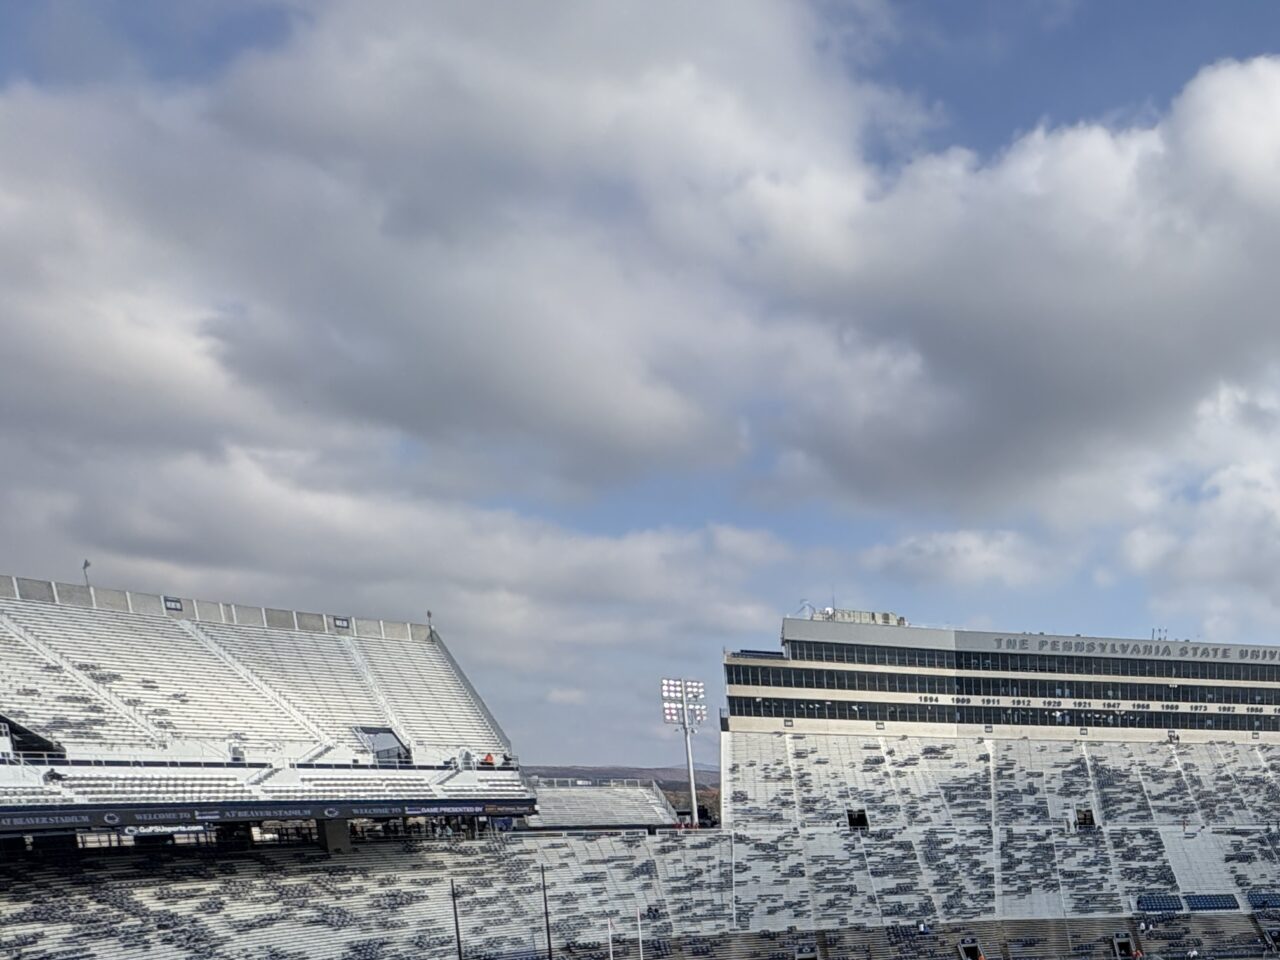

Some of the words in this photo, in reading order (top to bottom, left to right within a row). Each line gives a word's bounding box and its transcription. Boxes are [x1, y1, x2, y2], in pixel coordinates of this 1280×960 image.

[994, 638, 1029, 650] THE
[1038, 640, 1172, 657] PENNSYLVANIA
[1179, 646, 1232, 659] STATE
[982, 698, 1000, 706] 1911
[135, 813, 177, 821] WELCOME
